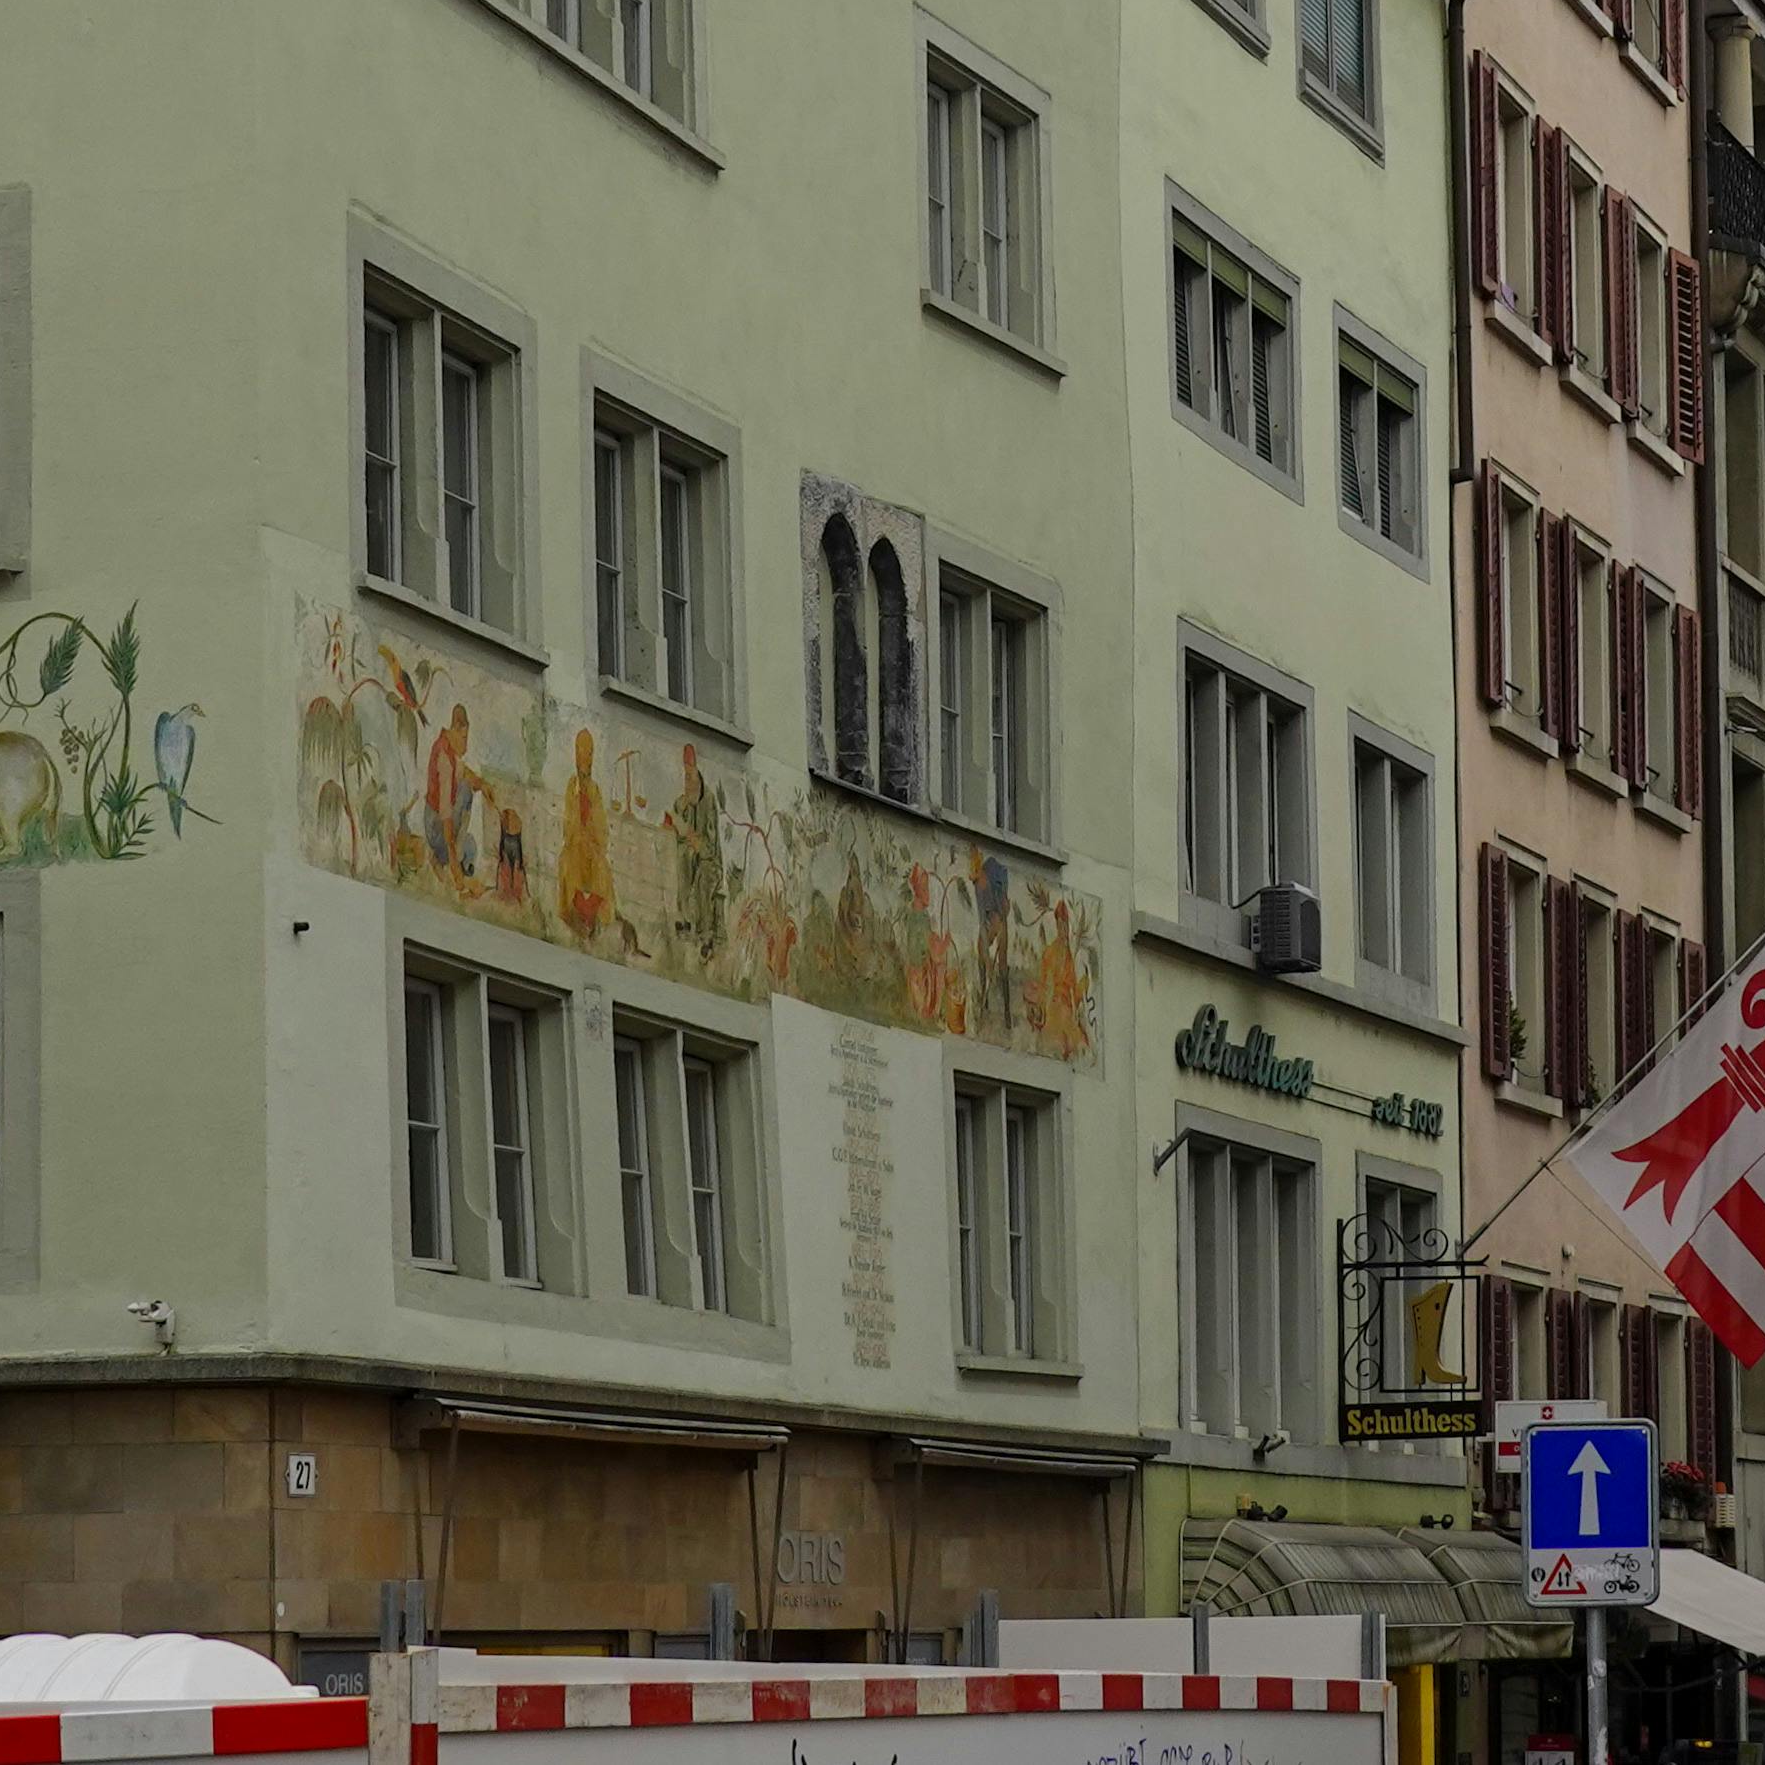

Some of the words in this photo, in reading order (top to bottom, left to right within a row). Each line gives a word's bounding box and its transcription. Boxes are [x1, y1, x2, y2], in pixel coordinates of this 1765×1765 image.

[1175, 1003, 1315, 1098] Schulthess
[1410, 1097, 1444, 1136] 1882
[1347, 1408, 1476, 1435] Schulthess
[296, 1460, 311, 1490] 27
[777, 1536, 843, 1585] ORIS
[325, 1672, 364, 1695] ORIS
